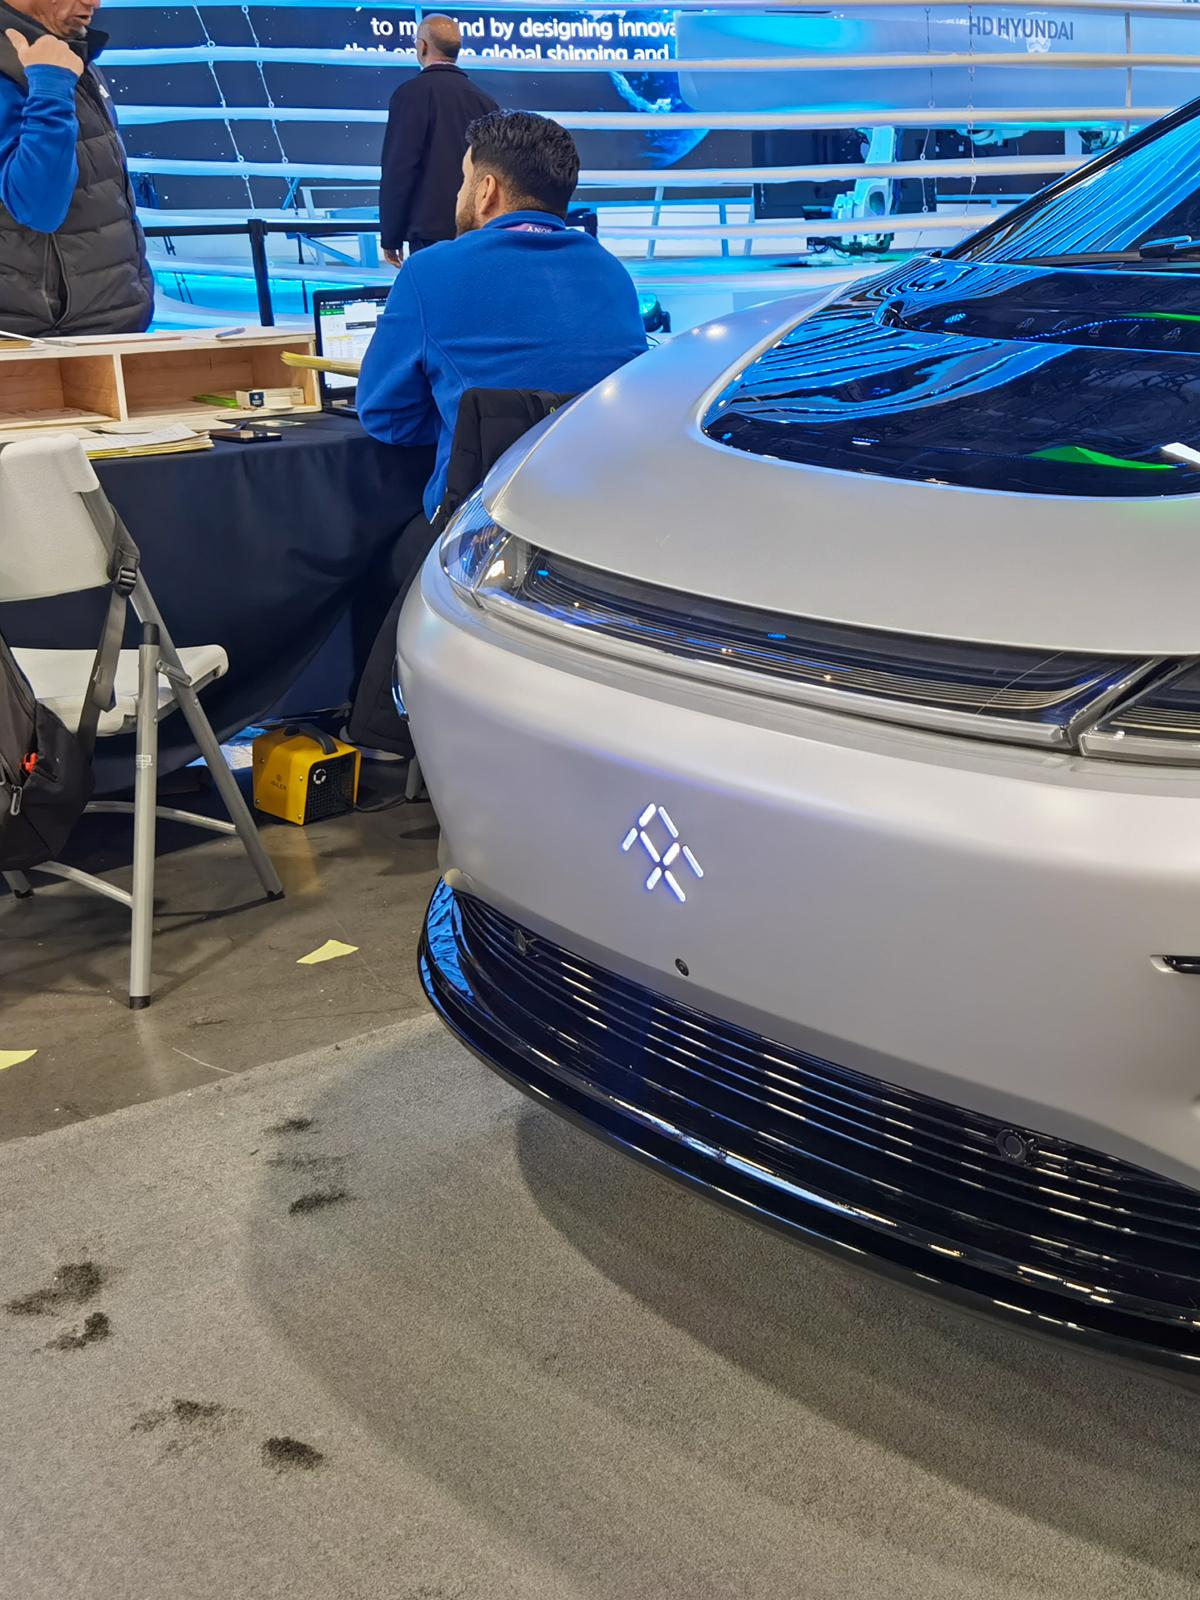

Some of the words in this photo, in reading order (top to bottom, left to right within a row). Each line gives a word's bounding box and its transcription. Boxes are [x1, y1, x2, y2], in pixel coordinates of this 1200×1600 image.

[370, 17, 393, 36] to
[490, 17, 514, 41] by
[519, 17, 613, 41] designing
[969, 15, 994, 36] HD
[998, 16, 1074, 41] HYUNDAI
[633, 44, 670, 60] and
